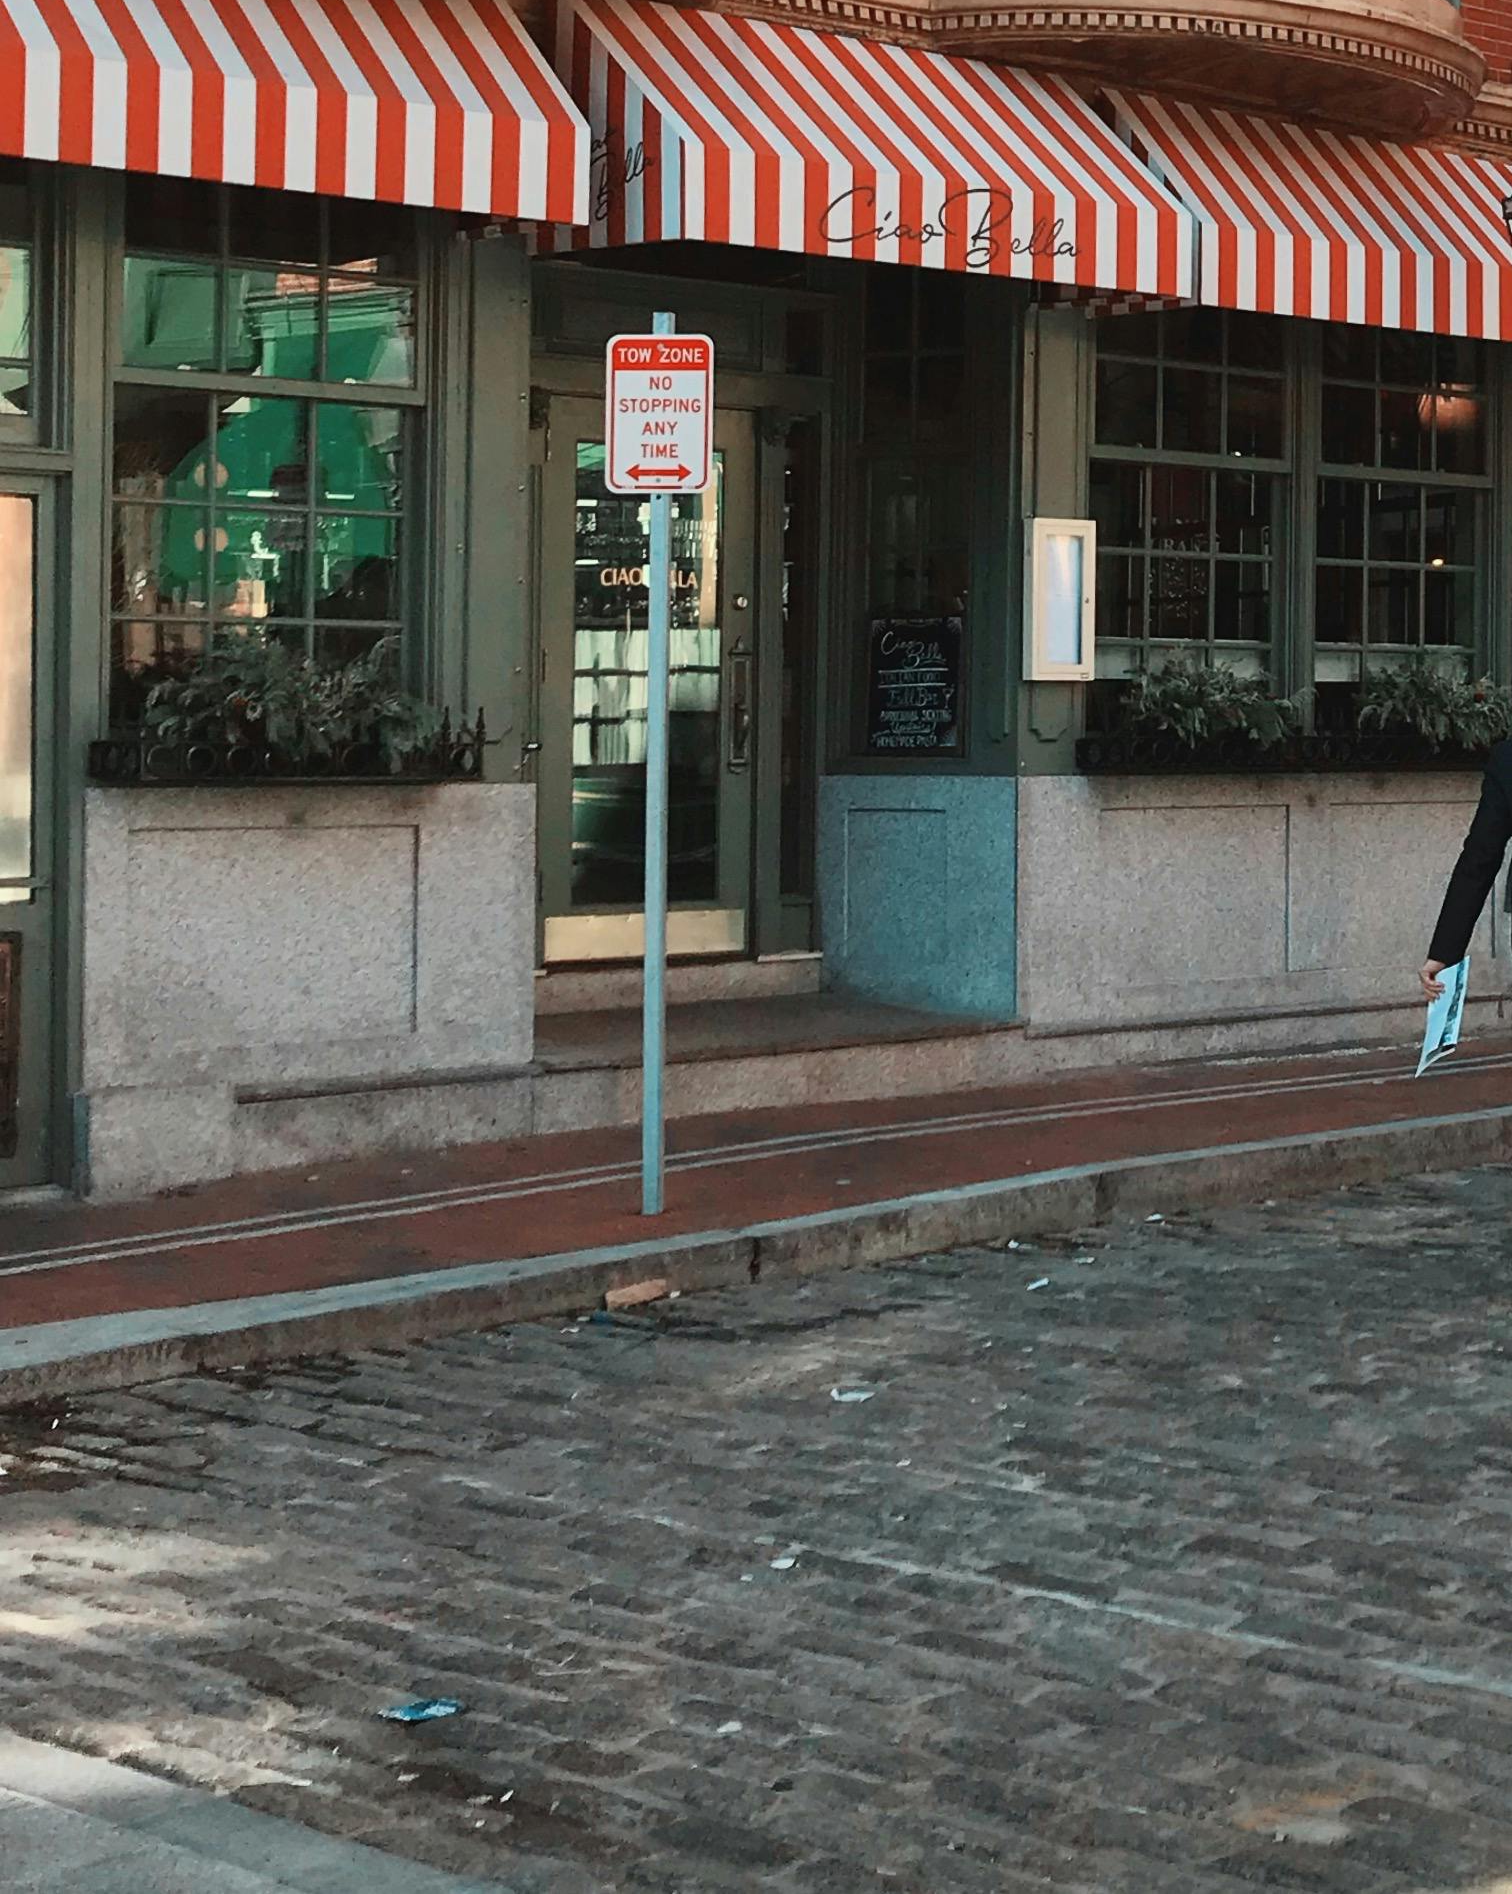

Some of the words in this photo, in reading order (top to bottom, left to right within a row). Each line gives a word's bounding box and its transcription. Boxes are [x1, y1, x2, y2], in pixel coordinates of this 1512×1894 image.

[819, 186, 943, 244] Ciao
[938, 188, 1081, 268] Bella
[618, 347, 652, 363] TOW
[659, 347, 704, 363] ZONE
[648, 376, 673, 391] NO
[619, 398, 702, 413] STOPPING
[641, 421, 678, 436] ANY
[641, 443, 679, 458] TIME
[600, 567, 643, 587] CIAO
